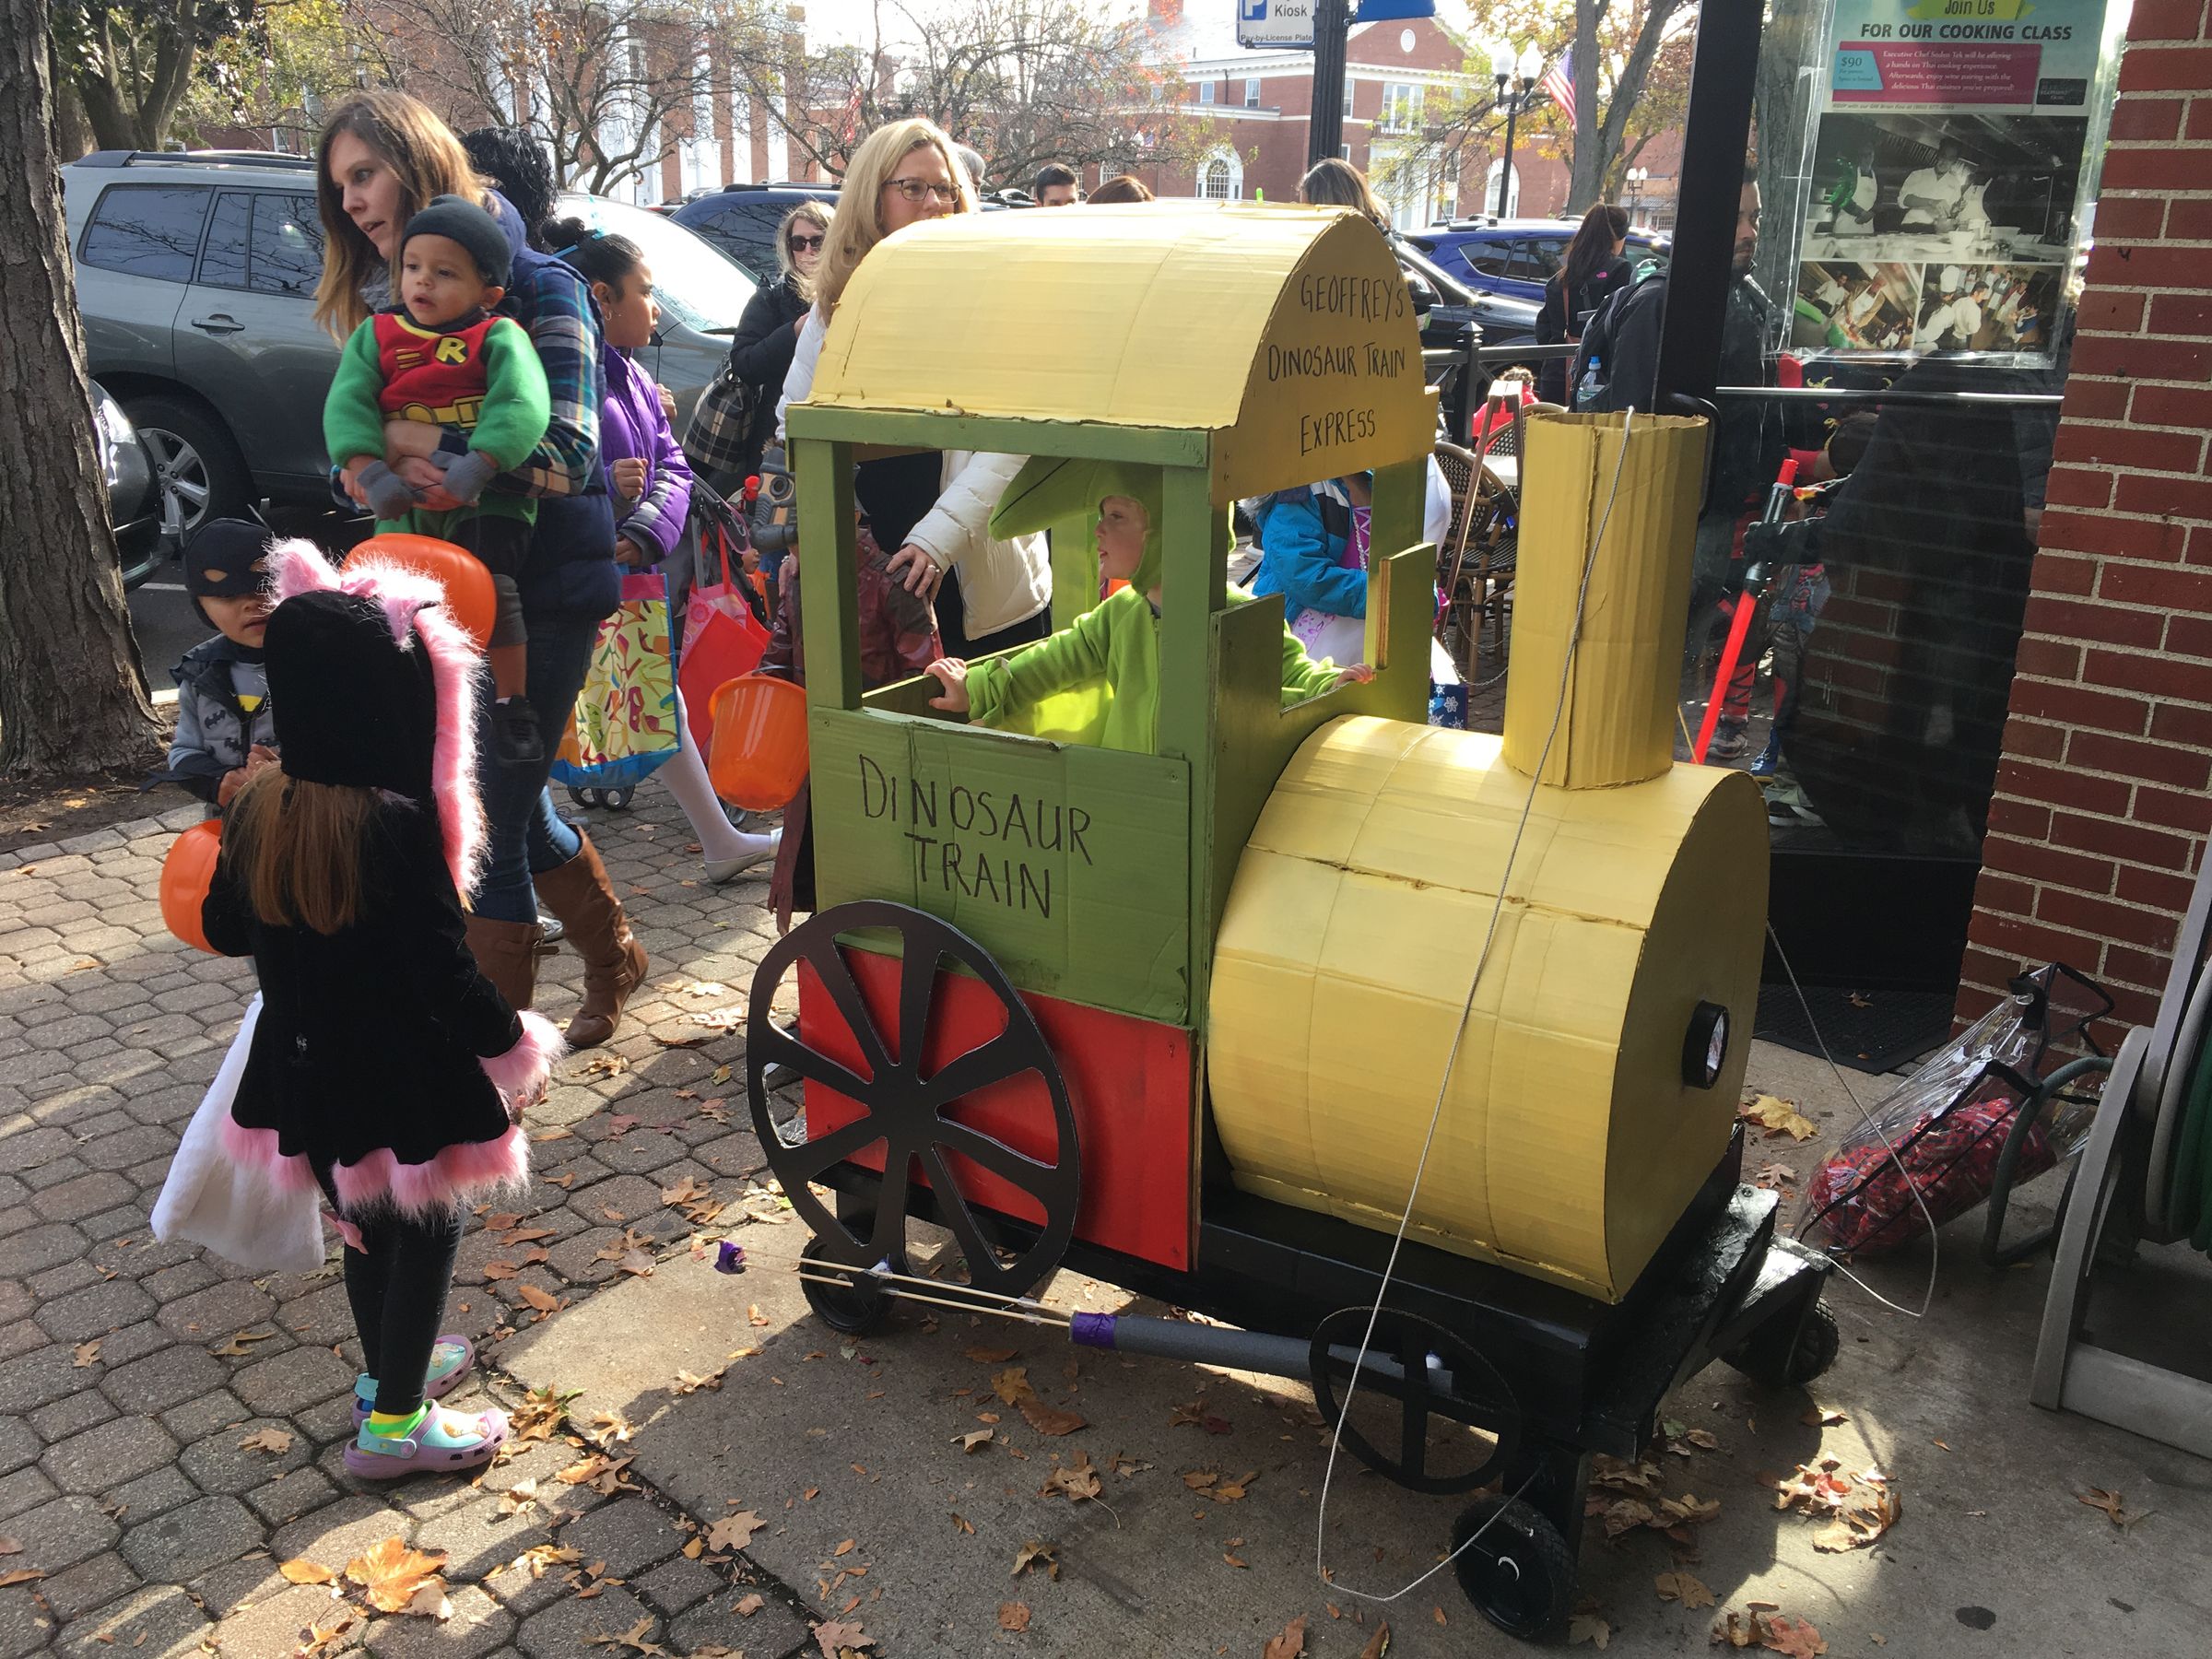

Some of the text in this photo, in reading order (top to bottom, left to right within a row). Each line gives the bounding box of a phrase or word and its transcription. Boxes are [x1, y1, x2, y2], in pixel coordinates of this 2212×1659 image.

[1275, 4, 1308, 17] Kiosk
[1945, 0, 1994, 16] Join Us
[1860, 24, 2072, 41] FOR OUR COOKING CLASS
[1841, 56, 1863, 68] $90
[1300, 273, 1405, 324] GEOFFREY'S
[435, 336, 466, 363] R
[1268, 341, 1406, 382] DINOSAUR TRAIN
[1300, 408, 1376, 457] EXPRESS
[859, 753, 1093, 865] DINOSAUR
[904, 831, 1050, 919] TRAIN
